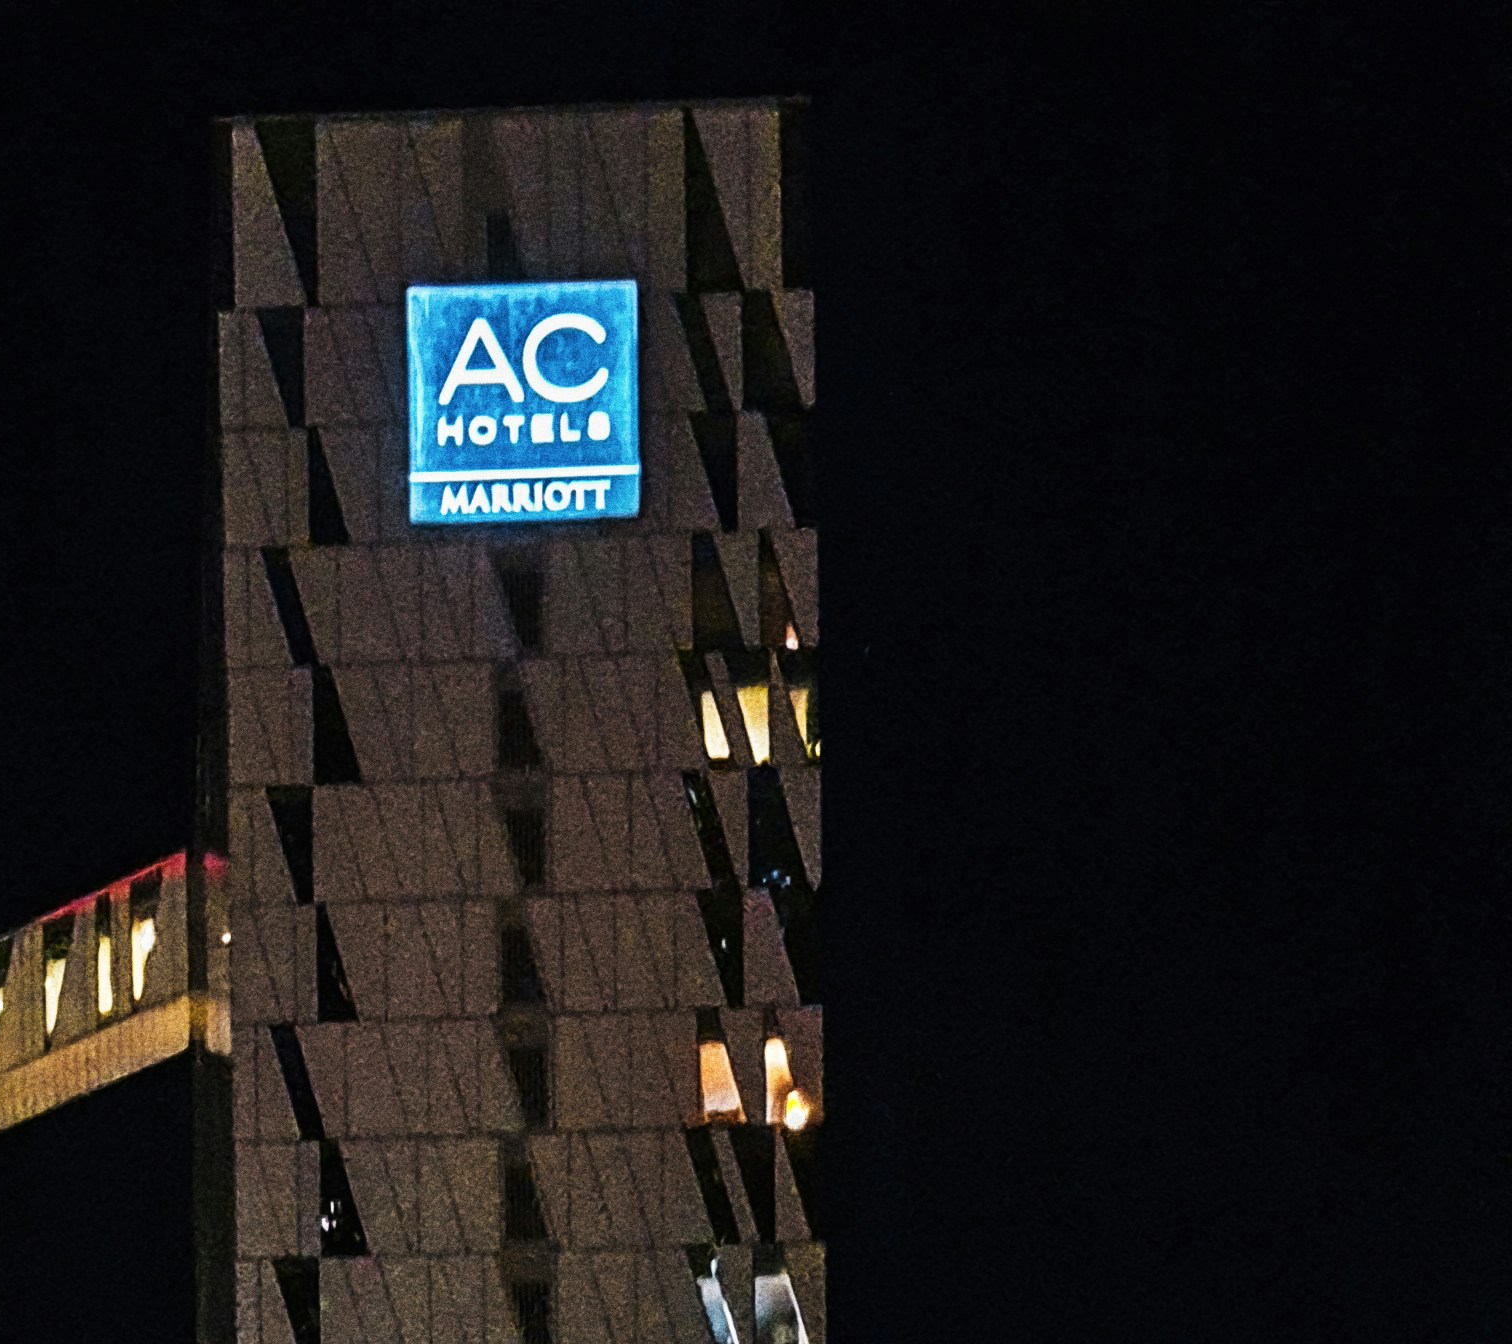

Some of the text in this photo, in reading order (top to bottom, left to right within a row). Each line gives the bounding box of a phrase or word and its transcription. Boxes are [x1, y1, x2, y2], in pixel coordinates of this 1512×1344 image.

[439, 312, 609, 406] AC
[437, 411, 611, 446] HOTELS
[440, 479, 611, 515] MARRIOTT
